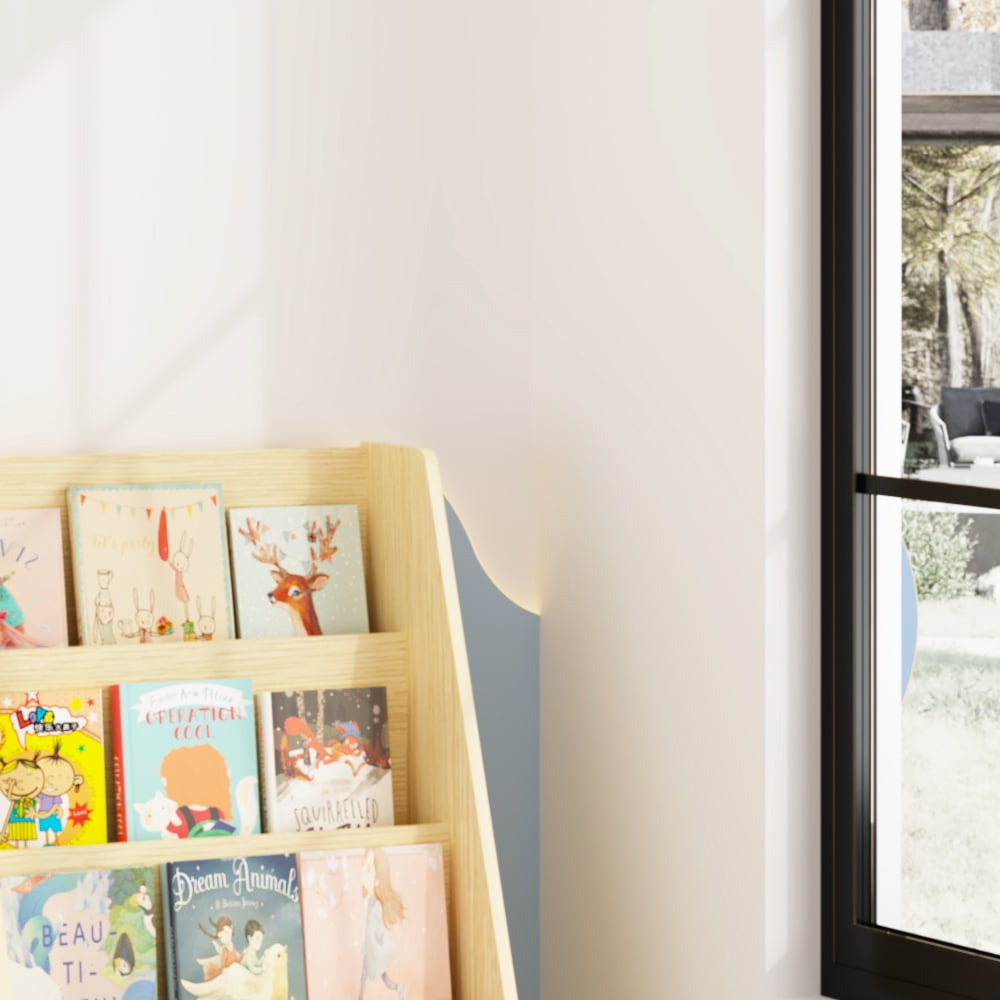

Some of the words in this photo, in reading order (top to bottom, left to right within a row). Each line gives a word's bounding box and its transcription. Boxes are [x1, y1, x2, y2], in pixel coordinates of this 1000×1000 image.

[145, 705, 242, 725] OPERATION
[174, 724, 215, 740] COOL
[293, 797, 379, 832] SQUIRRELLED
[171, 866, 229, 913] Dream
[232, 856, 299, 903] Animals
[62, 960, 97, 984] TI-
